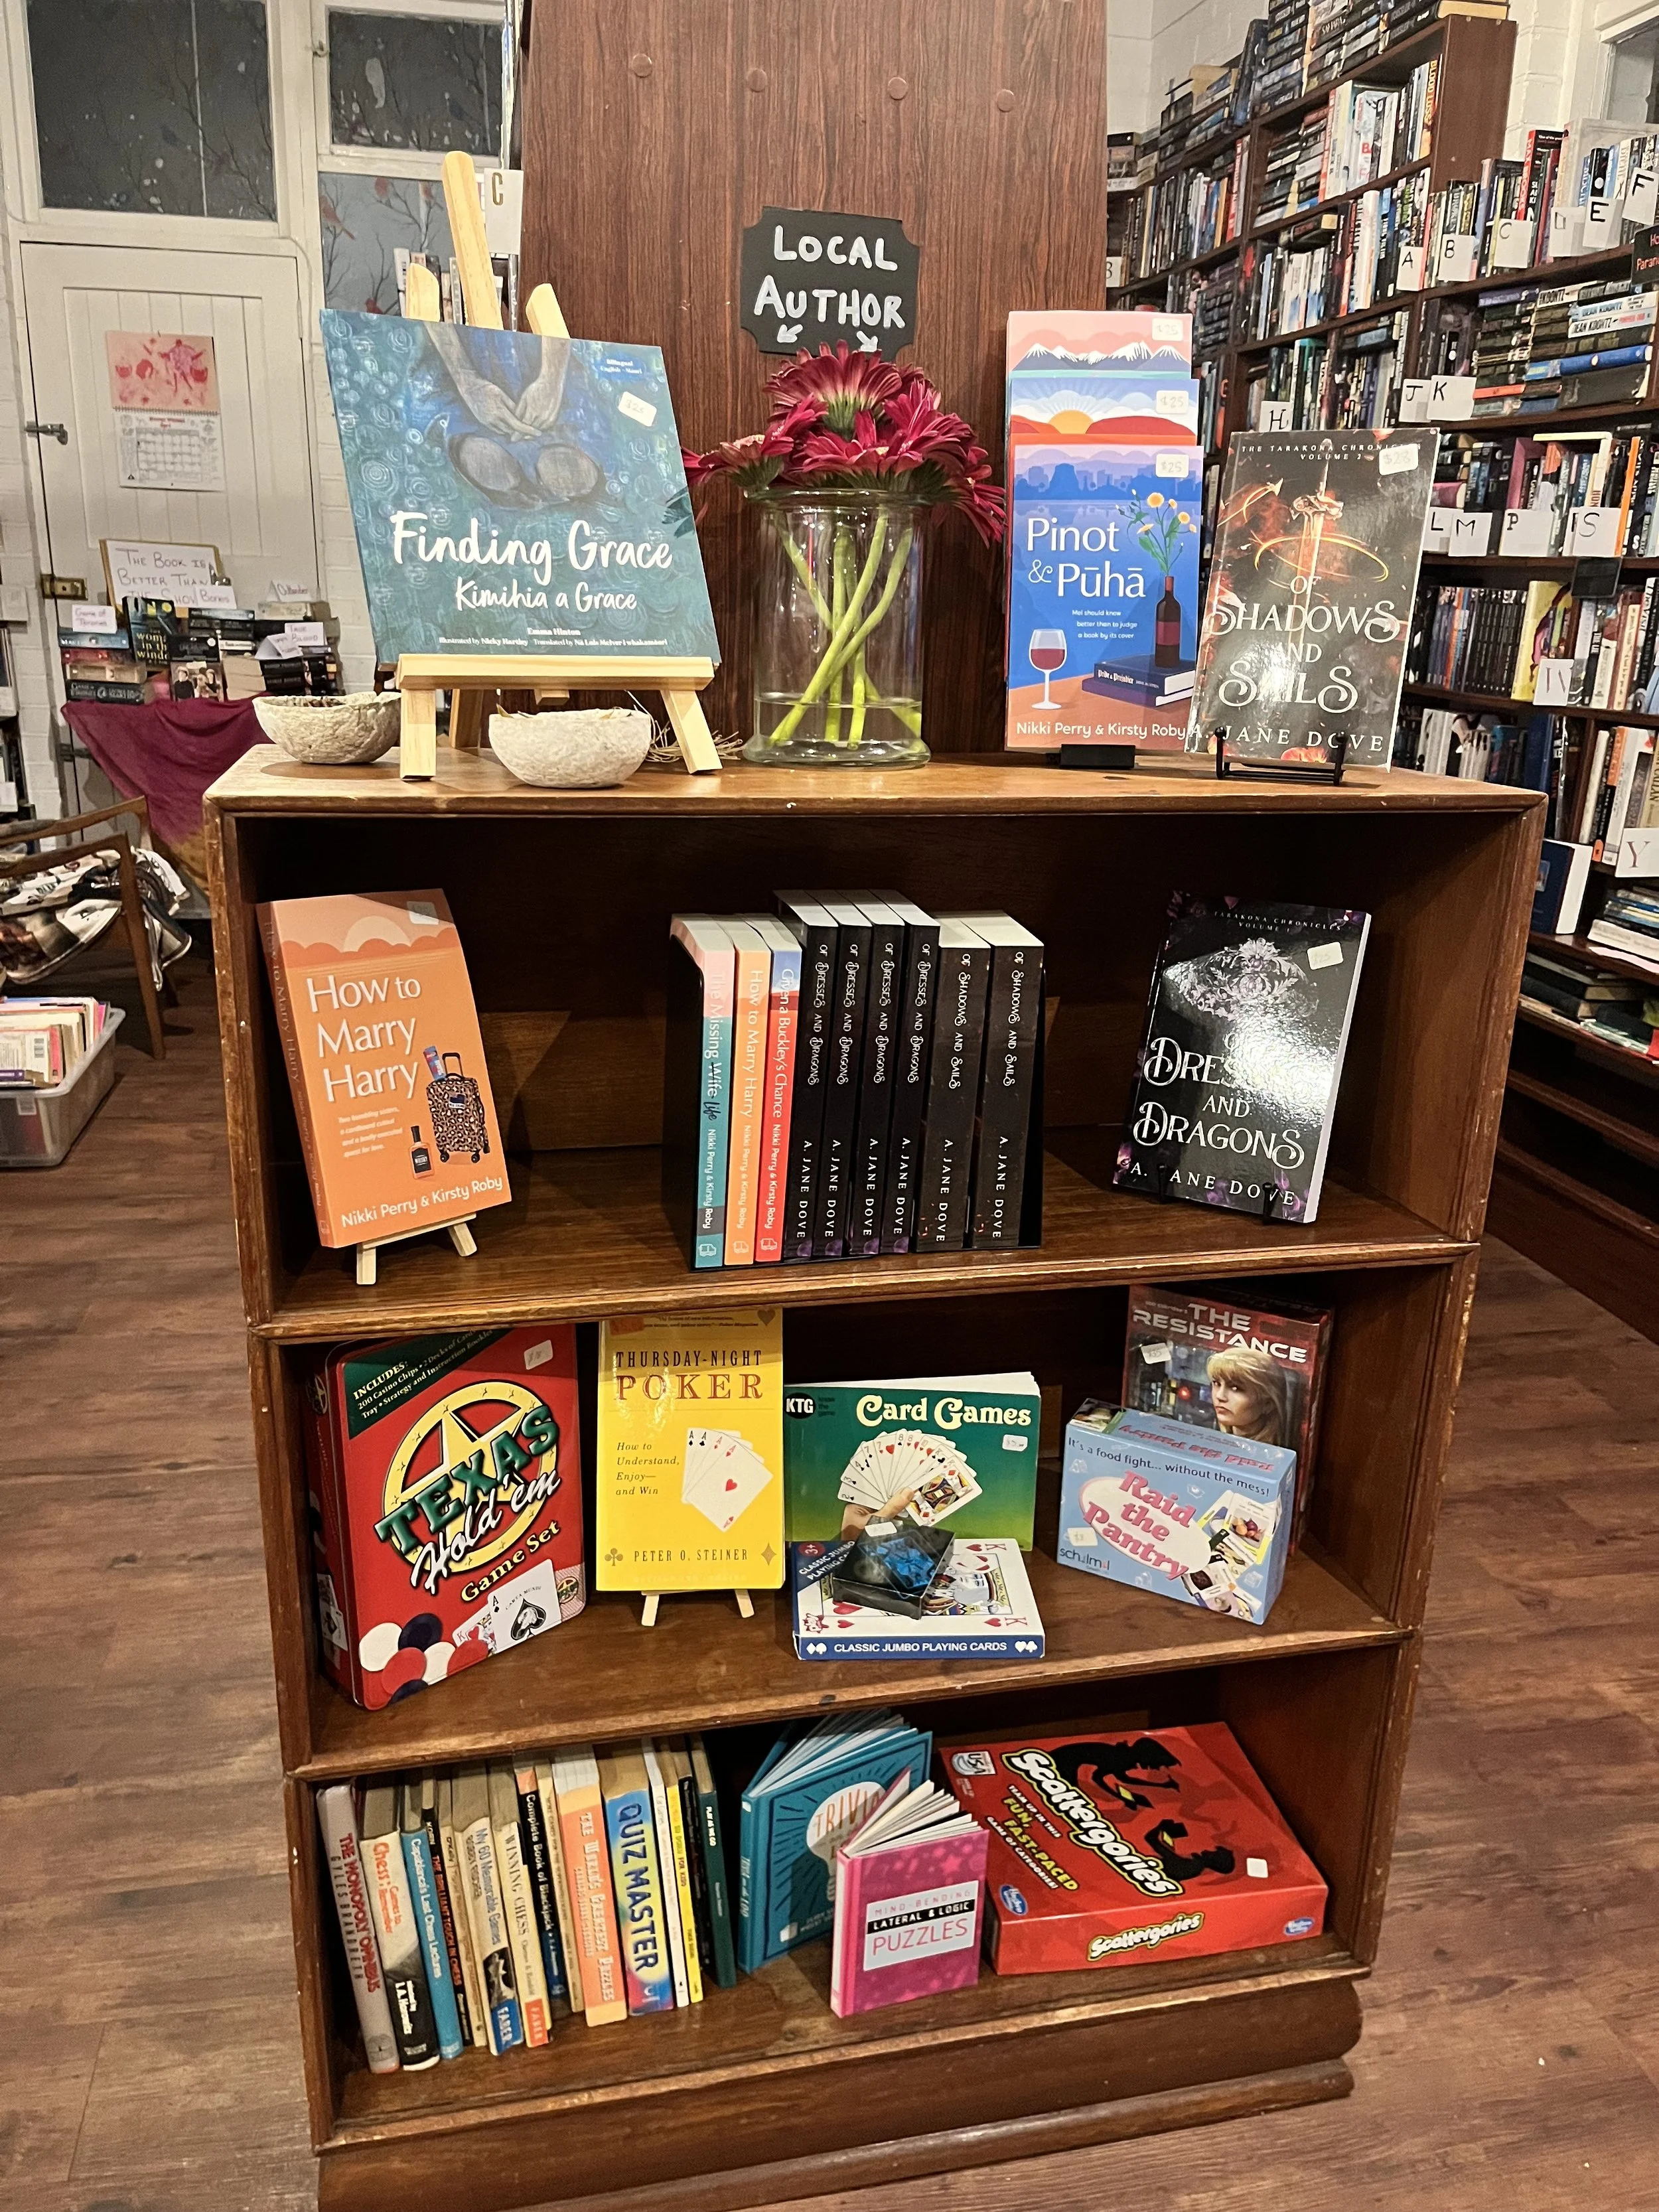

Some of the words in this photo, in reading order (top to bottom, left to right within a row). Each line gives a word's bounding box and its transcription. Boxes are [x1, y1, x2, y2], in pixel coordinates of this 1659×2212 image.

[491, 172, 504, 206] C
[1632, 173, 1654, 197] F
[1590, 201, 1609, 222] E
[774, 225, 899, 271] LOCAL
[1498, 222, 1513, 240] C
[1401, 251, 1414, 269] A
[1444, 239, 1455, 259] B
[753, 274, 906, 330] AUTHOR
[1406, 384, 1424, 402] J
[1433, 381, 1448, 402] K
[1269, 408, 1289, 431] H
[1270, 444, 1334, 453] TARAKONA
[1027, 516, 1121, 553] Pinot
[1430, 511, 1443, 532] L
[1455, 518, 1476, 538] M
[1506, 512, 1519, 531] P
[1578, 512, 1601, 538] S
[390, 510, 553, 587] Finding
[567, 520, 674, 571] Grace
[116, 567, 168, 586] BETTER
[170, 573, 209, 587] THAN
[1028, 559, 1053, 584] &
[1057, 560, 1147, 598] Pūhā
[1289, 575, 1322, 596] OF
[455, 576, 548, 612] Kimihia
[555, 591, 569, 610] a
[574, 581, 638, 613] Grace
[1204, 599, 1402, 644] SHADOWS
[1016, 721, 1051, 735] Nikki
[1054, 722, 1092, 739] Perry
[1094, 724, 1105, 736] &
[1108, 723, 1149, 740] Kirsty
[1151, 723, 1187, 741] Roby
[1626, 841, 1651, 868] Y
[819, 943, 828, 957] OF
[961, 952, 973, 968] OF
[1015, 950, 1025, 965] OF
[305, 973, 390, 1014] How
[394, 975, 421, 1000] to
[709, 973, 727, 999] The
[748, 970, 764, 1006] How
[813, 961, 830, 1009] DRESSES
[953, 971, 972, 1027] SHADOWS
[1007, 969, 1025, 1025] SHADOWS
[703, 1003, 724, 1059] Missing
[748, 1010, 760, 1025] to
[813, 1013, 824, 1033] AND
[317, 1016, 417, 1060] Marry
[742, 1029, 760, 1074] Marry
[954, 1031, 964, 1053] AND
[1007, 1029, 1017, 1049] AND
[807, 1037, 824, 1086] DRAGONS
[948, 1055, 965, 1090] SAILS
[1002, 1053, 1019, 1087] SAILS
[321, 1061, 419, 1103] Harry
[707, 1061, 723, 1098] Wife
[703, 1101, 721, 1121] Life
[739, 1077, 758, 1119] Harry
[1202, 1094, 1250, 1118] AND
[707, 1129, 717, 1150] Nikki
[803, 1140, 813, 1153] A.
[943, 1138, 954, 1153] A.
[1133, 1101, 1306, 1170] DRAGONS
[704, 1151, 715, 1174] Perry
[800, 1157, 811, 1194] JANE
[939, 1155, 951, 1195] JANE
[340, 1205, 379, 1228] Nikki
[380, 1197, 419, 1219] Perry
[419, 1193, 431, 1208] &
[431, 1184, 470, 1207] Kirsty
[470, 1175, 504, 1196] Roby
[703, 1182, 715, 1207] Kirsty
[702, 1208, 713, 1229] Roby
[796, 1200, 809, 1239] DOVE
[934, 1202, 948, 1242] DOVE
[1187, 1302, 1252, 1333] THE
[1132, 1309, 1308, 1364] RESISTANCE
[615, 1349, 763, 1368] THURSDAY-NIGHT
[352, 1360, 409, 1400] INCLUDES:
[615, 1372, 763, 1401] POKER
[785, 1397, 814, 1414] KTG
[855, 1394, 928, 1428] Card
[933, 1396, 1033, 1430] Games
[616, 1441, 639, 1451] How
[642, 1442, 653, 1451] to
[616, 1456, 681, 1467] Understand,
[373, 1404, 561, 1557] TEXAS
[1068, 1437, 1085, 1451] It's
[1096, 1447, 1121, 1462] food
[1165, 1463, 1211, 1480] without
[1214, 1473, 1234, 1485] the
[1236, 1479, 1270, 1498] mess!
[615, 1487, 636, 1497] and
[639, 1486, 660, 1496] Win
[1118, 1469, 1198, 1528] Raid
[408, 1468, 563, 1596] Hold'em
[1119, 1501, 1170, 1542] the
[634, 1549, 673, 1563] PETER
[696, 1548, 749, 1562] STEINER
[1084, 1500, 1191, 1582] Pantry
[460, 1550, 526, 1604] Game
[528, 1519, 561, 1554] Set
[833, 1642, 881, 1653] CLASSIC
[881, 1642, 921, 1653] JUMBO
[922, 1641, 968, 1653] PLAYING
[969, 1641, 1008, 1652] CARDS
[815, 1788, 880, 1838] TRIVIA
[1003, 1797, 1033, 1827] FUN,
[1011, 1751, 1176, 1896] Scattergories
[475, 1827, 488, 1845] My
[616, 1802, 648, 1865] QUIZ
[478, 1845, 491, 1860] 60
[505, 1834, 524, 1893] WINNING
[1003, 1819, 1079, 1891] FAST-PACED
[480, 1860, 498, 1913] Memorable
[514, 1897, 530, 1936] CHESS
[624, 1866, 660, 1973] MASTER
[873, 1911, 923, 1930] LATERAL
[938, 1901, 970, 1915] LOGIC
[872, 1917, 968, 1956] PUZZLES
[1088, 1915, 1202, 1959] Scattergories
